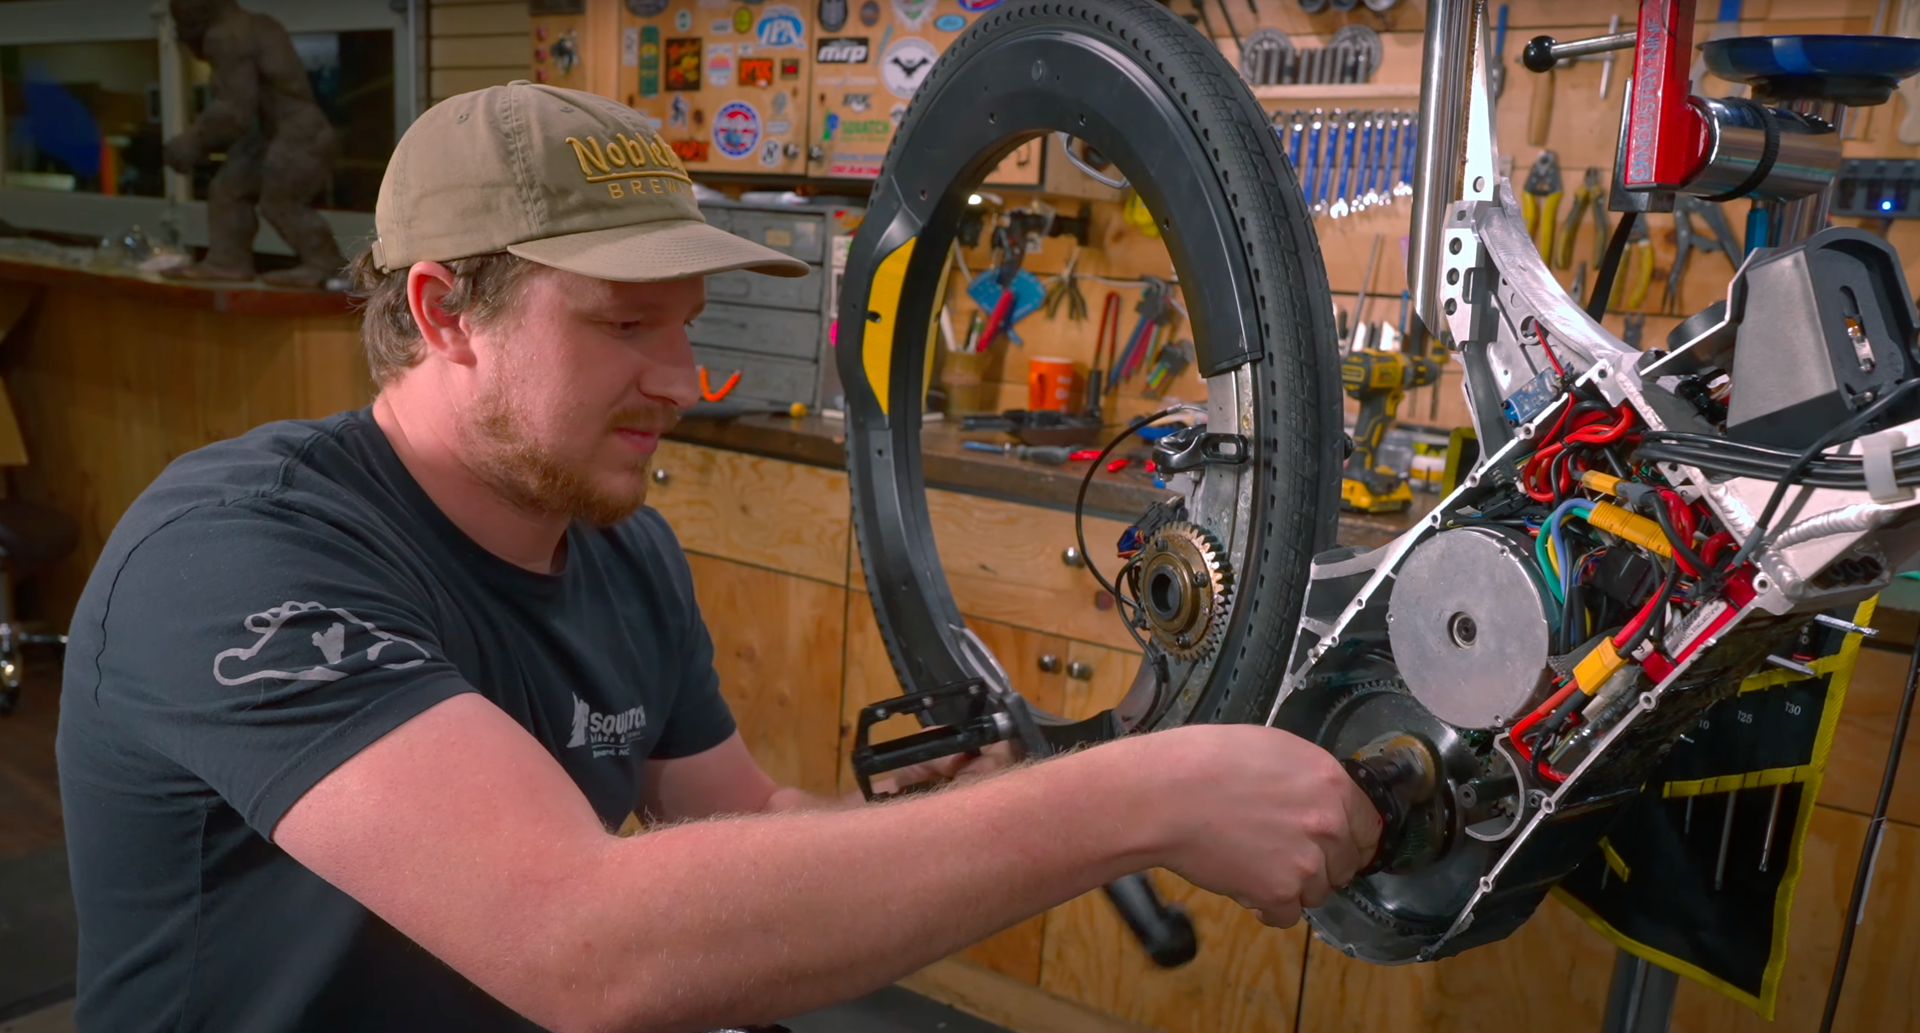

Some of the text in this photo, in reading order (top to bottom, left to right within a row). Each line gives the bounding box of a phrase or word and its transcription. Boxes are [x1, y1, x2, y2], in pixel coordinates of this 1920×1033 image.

[759, 18, 800, 46] IPA
[818, 45, 867, 64] mrp
[1634, 67, 1657, 159] INDUSTRY
[1737, 709, 1753, 724] T25
[1785, 702, 1801, 715] T30
[589, 705, 646, 736] SQUTCH
